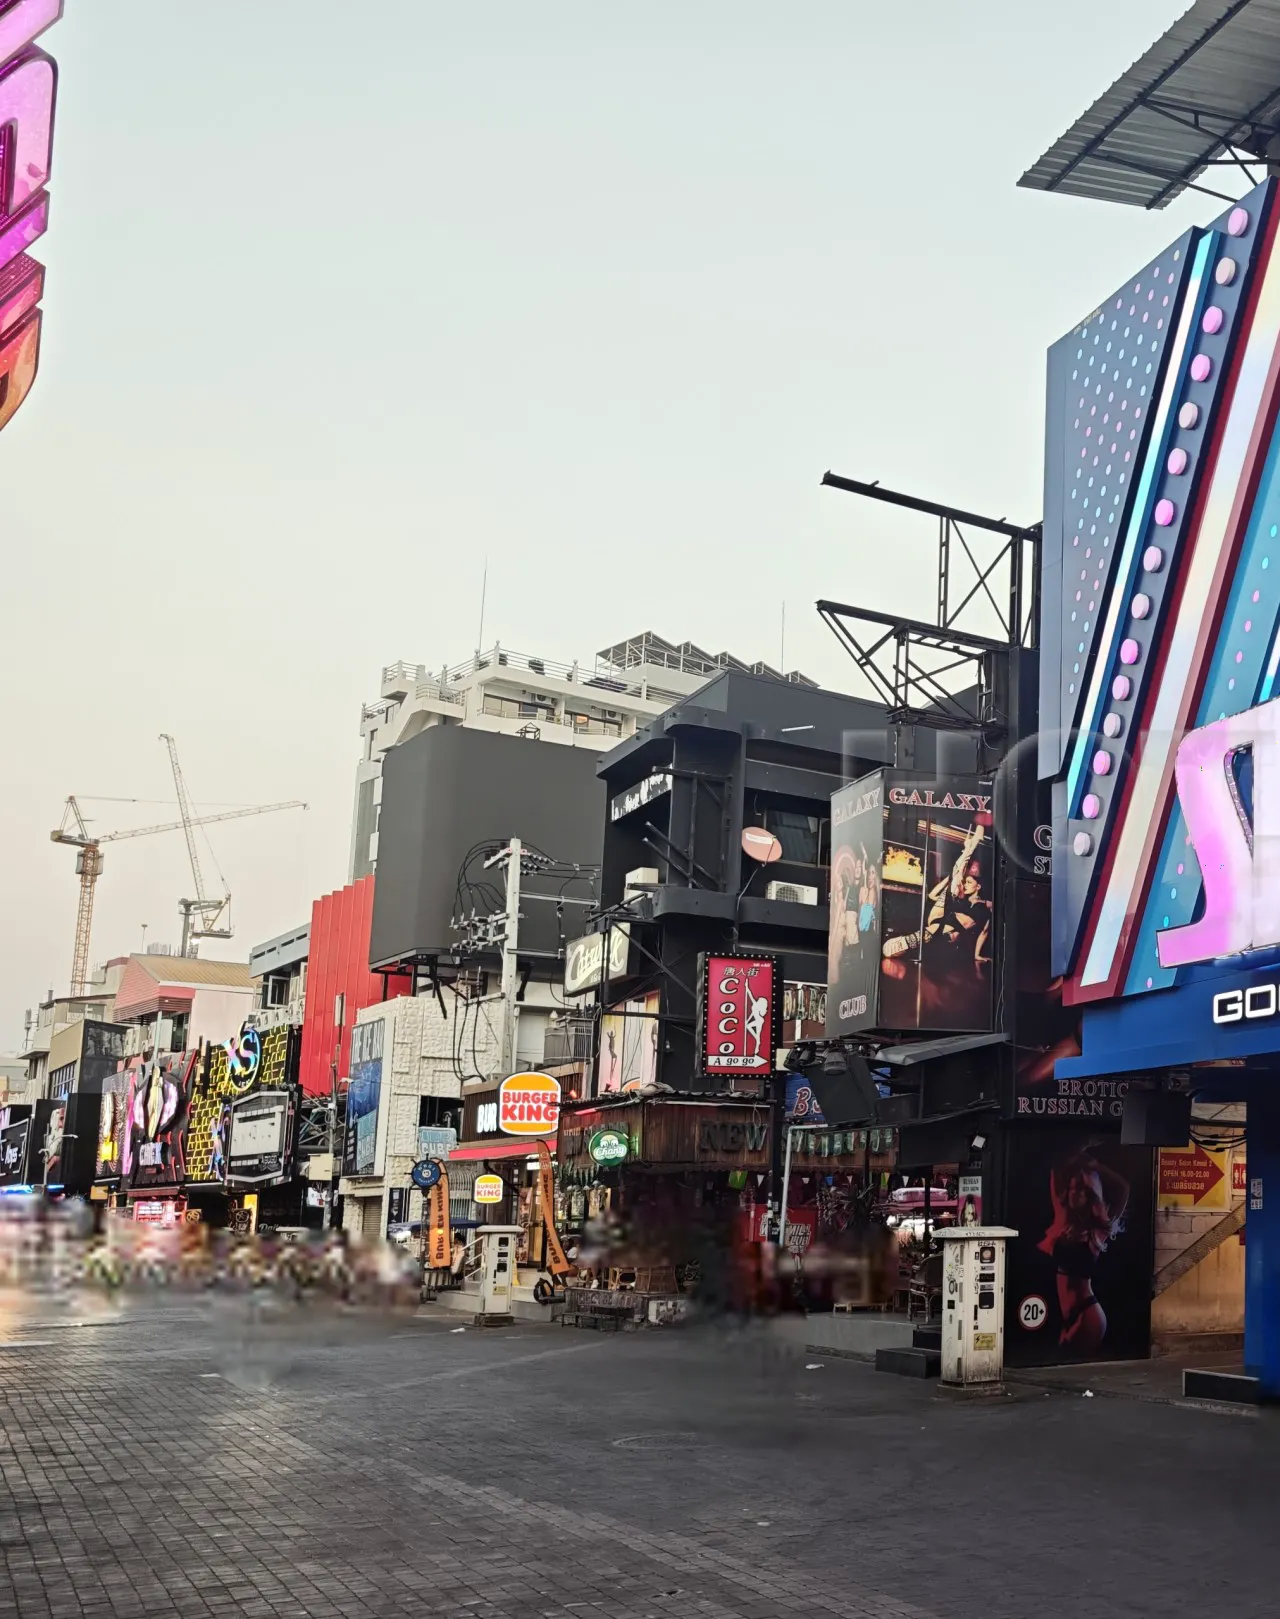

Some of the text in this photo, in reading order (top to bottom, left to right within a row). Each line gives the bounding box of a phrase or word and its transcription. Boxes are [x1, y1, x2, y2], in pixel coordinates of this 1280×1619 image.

[833, 788, 881, 827] GALAXY
[889, 788, 992, 813] GALAXY
[839, 994, 867, 1020] CLUB
[502, 1091, 558, 1104] BURGER
[1058, 1080, 1130, 1098] EROTIC
[501, 1104, 560, 1122] KING
[1018, 1097, 1104, 1116] RUSSIAN
[701, 1122, 767, 1151] NEW
[595, 1147, 625, 1158] Chang
[476, 1189, 501, 1197] KING
[1023, 1304, 1045, 1321] 20+
